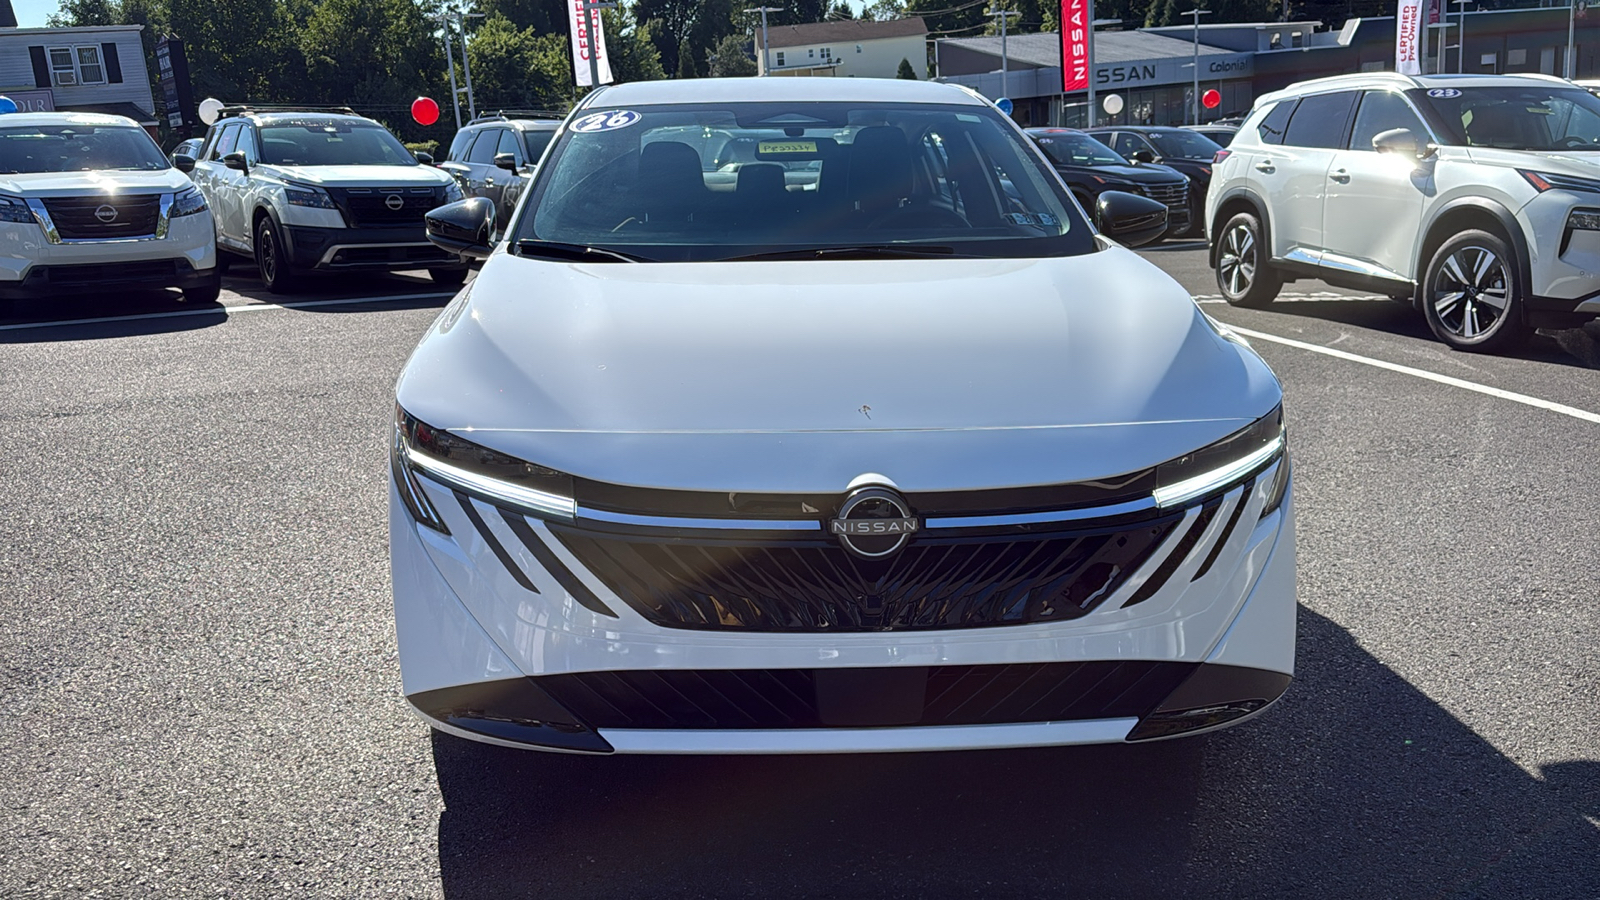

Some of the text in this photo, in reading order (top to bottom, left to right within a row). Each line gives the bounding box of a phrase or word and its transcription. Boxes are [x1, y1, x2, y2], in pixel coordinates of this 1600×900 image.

[1071, 0, 1085, 80] NISSAN
[1400, 5, 1410, 62] CERTIFIED
[1407, 5, 1418, 62] Pre-Owned
[1096, 65, 1156, 84] SSAN
[1209, 59, 1248, 73] Colonial
[1431, 88, 1455, 97] 23
[579, 110, 631, 131] 26
[834, 520, 916, 532] NISSAN
